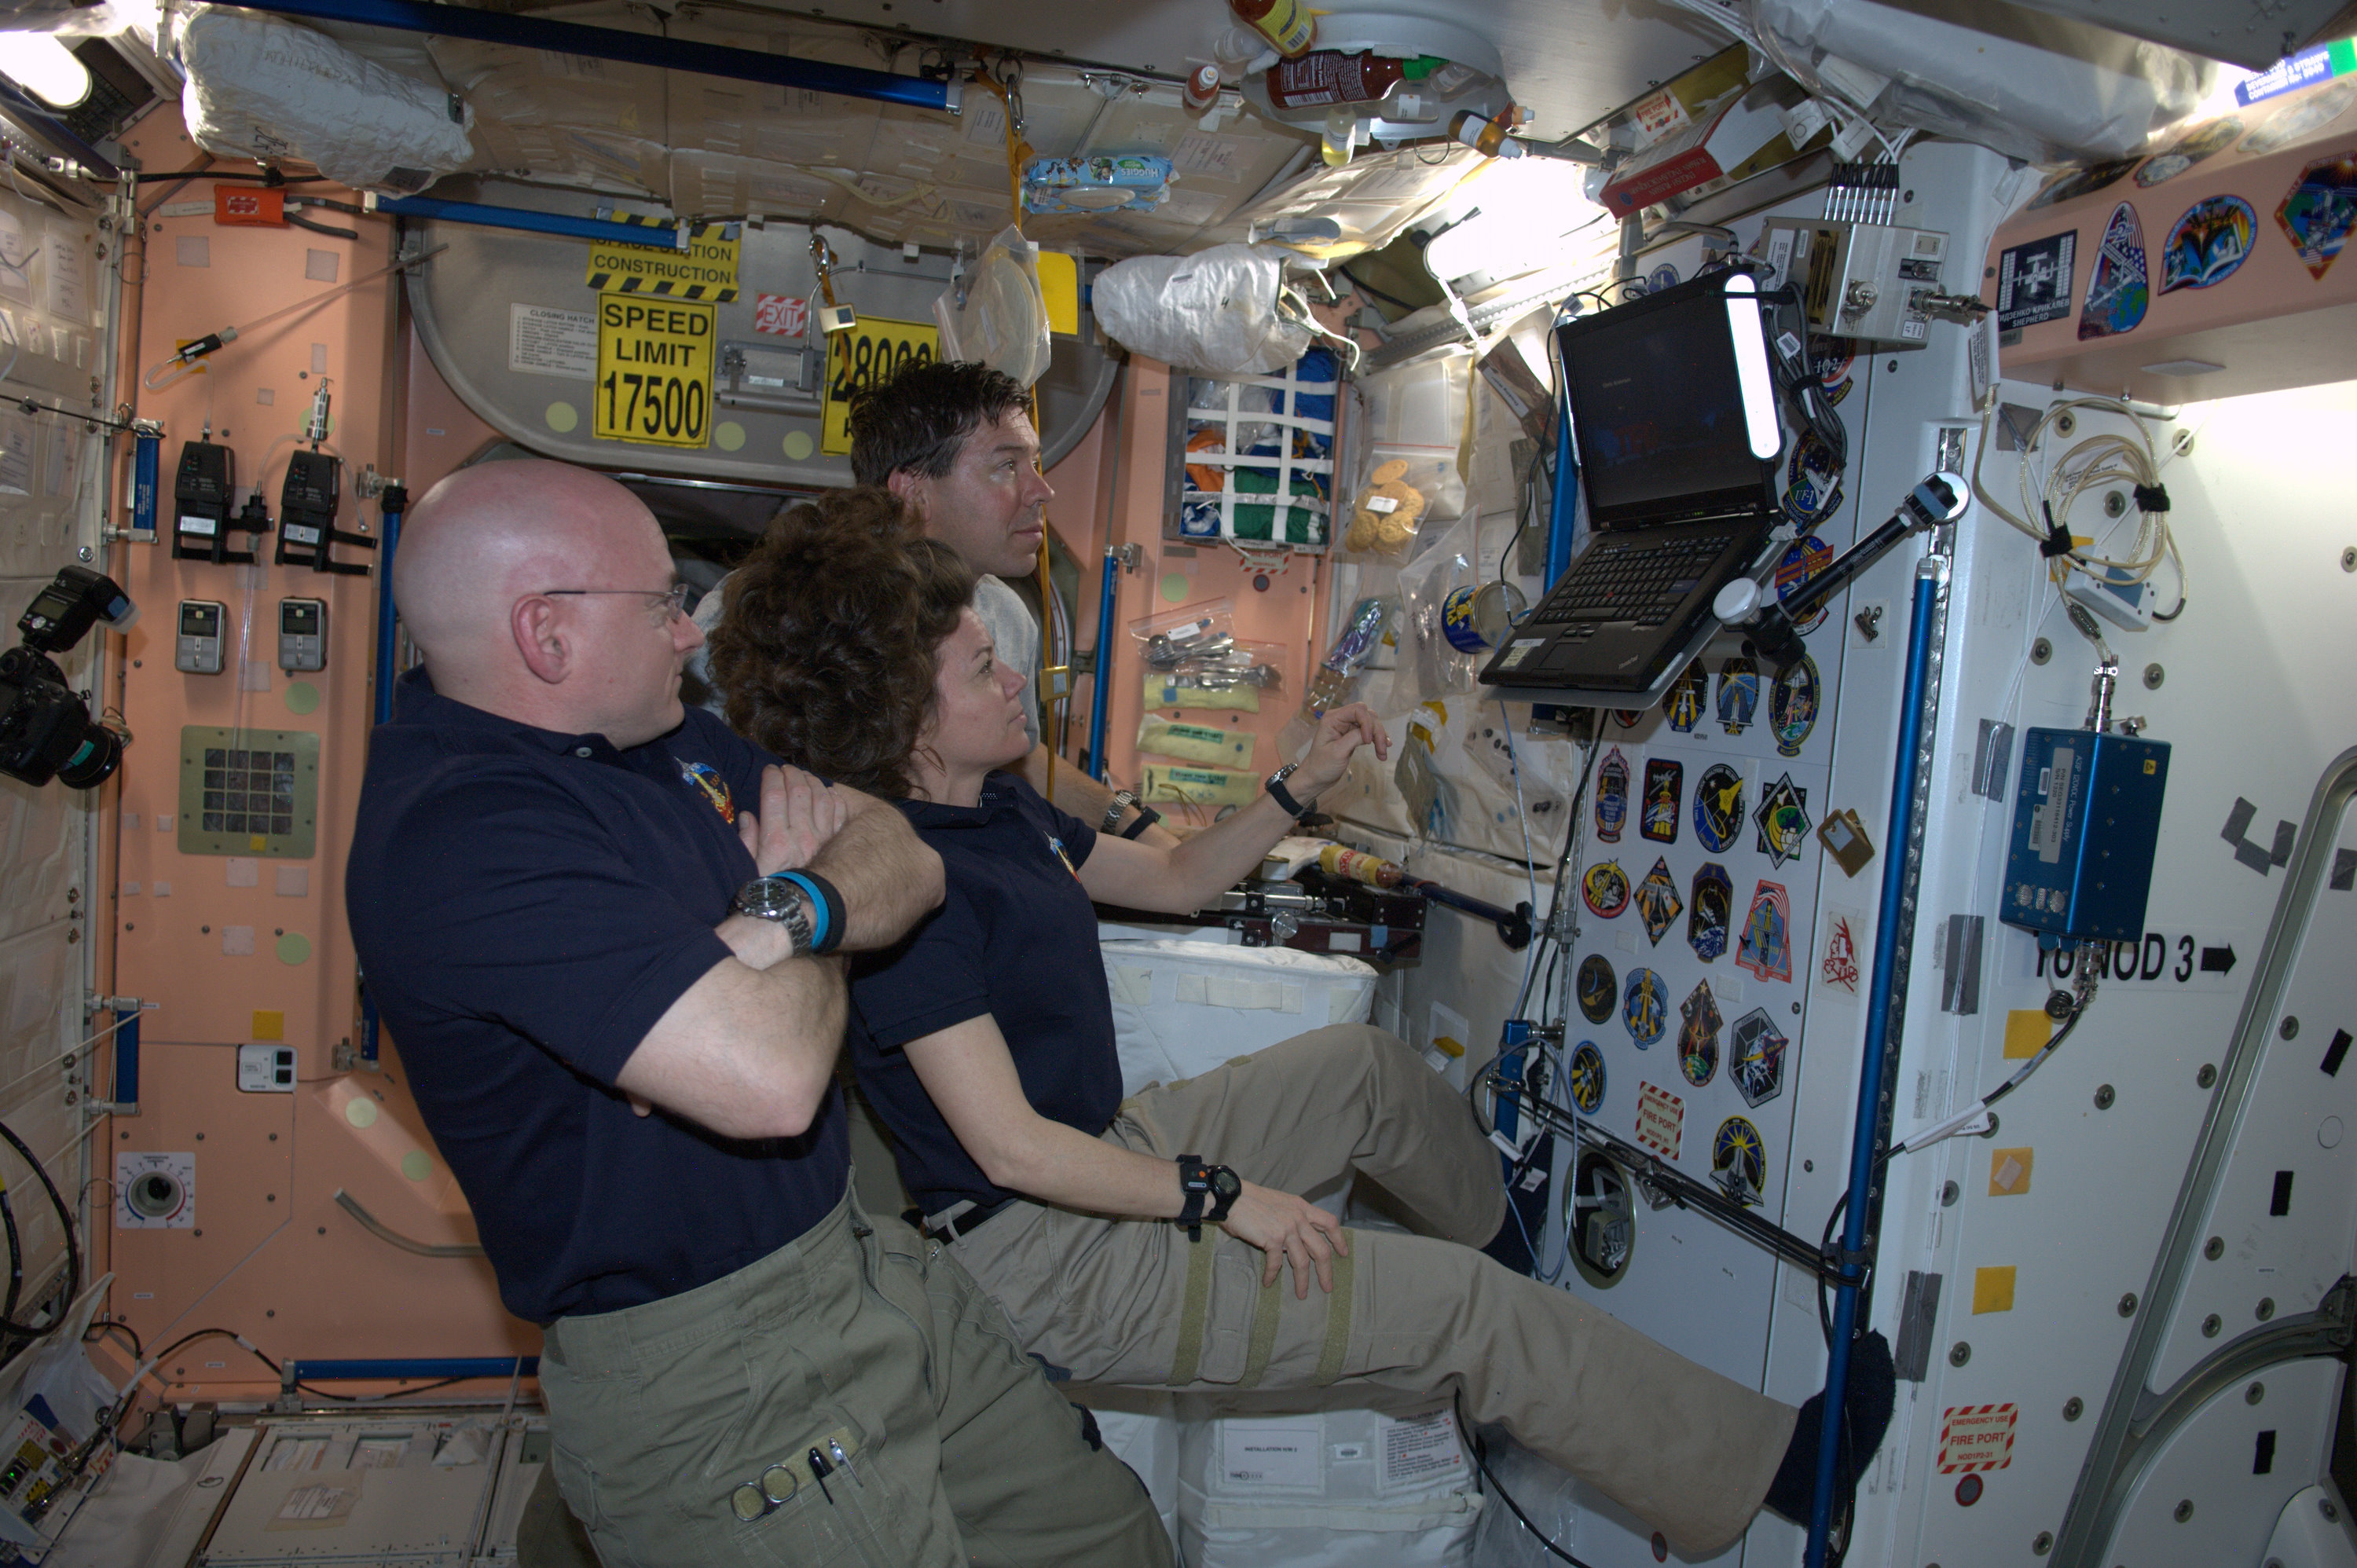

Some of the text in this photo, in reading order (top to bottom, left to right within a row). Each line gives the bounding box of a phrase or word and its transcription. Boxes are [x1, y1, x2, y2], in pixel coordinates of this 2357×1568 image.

[1120, 167, 1160, 178] HUGGIES
[593, 254, 731, 284] CONSTRUCTION
[530, 309, 595, 324] CLOSING HATCH
[603, 302, 709, 337] SPEED
[764, 302, 800, 332] EXIT
[1998, 307, 2031, 323] ИДЗЕНКО
[2012, 312, 2049, 328] SHEPHERD
[616, 337, 697, 368] LIMIT
[830, 332, 933, 402] 280
[603, 370, 705, 439] 17500
[1794, 489, 1815, 506] UF-1
[2068, 799, 2077, 819] Power
[1604, 821, 1615, 831] 117
[2062, 821, 2073, 842] Supply
[2175, 935, 2195, 983] 3
[1642, 1108, 1677, 1134] FIRE PORT
[1951, 1415, 2009, 1427] EMERGENCY USE
[1950, 1432, 2007, 1446] FIRE PORT
